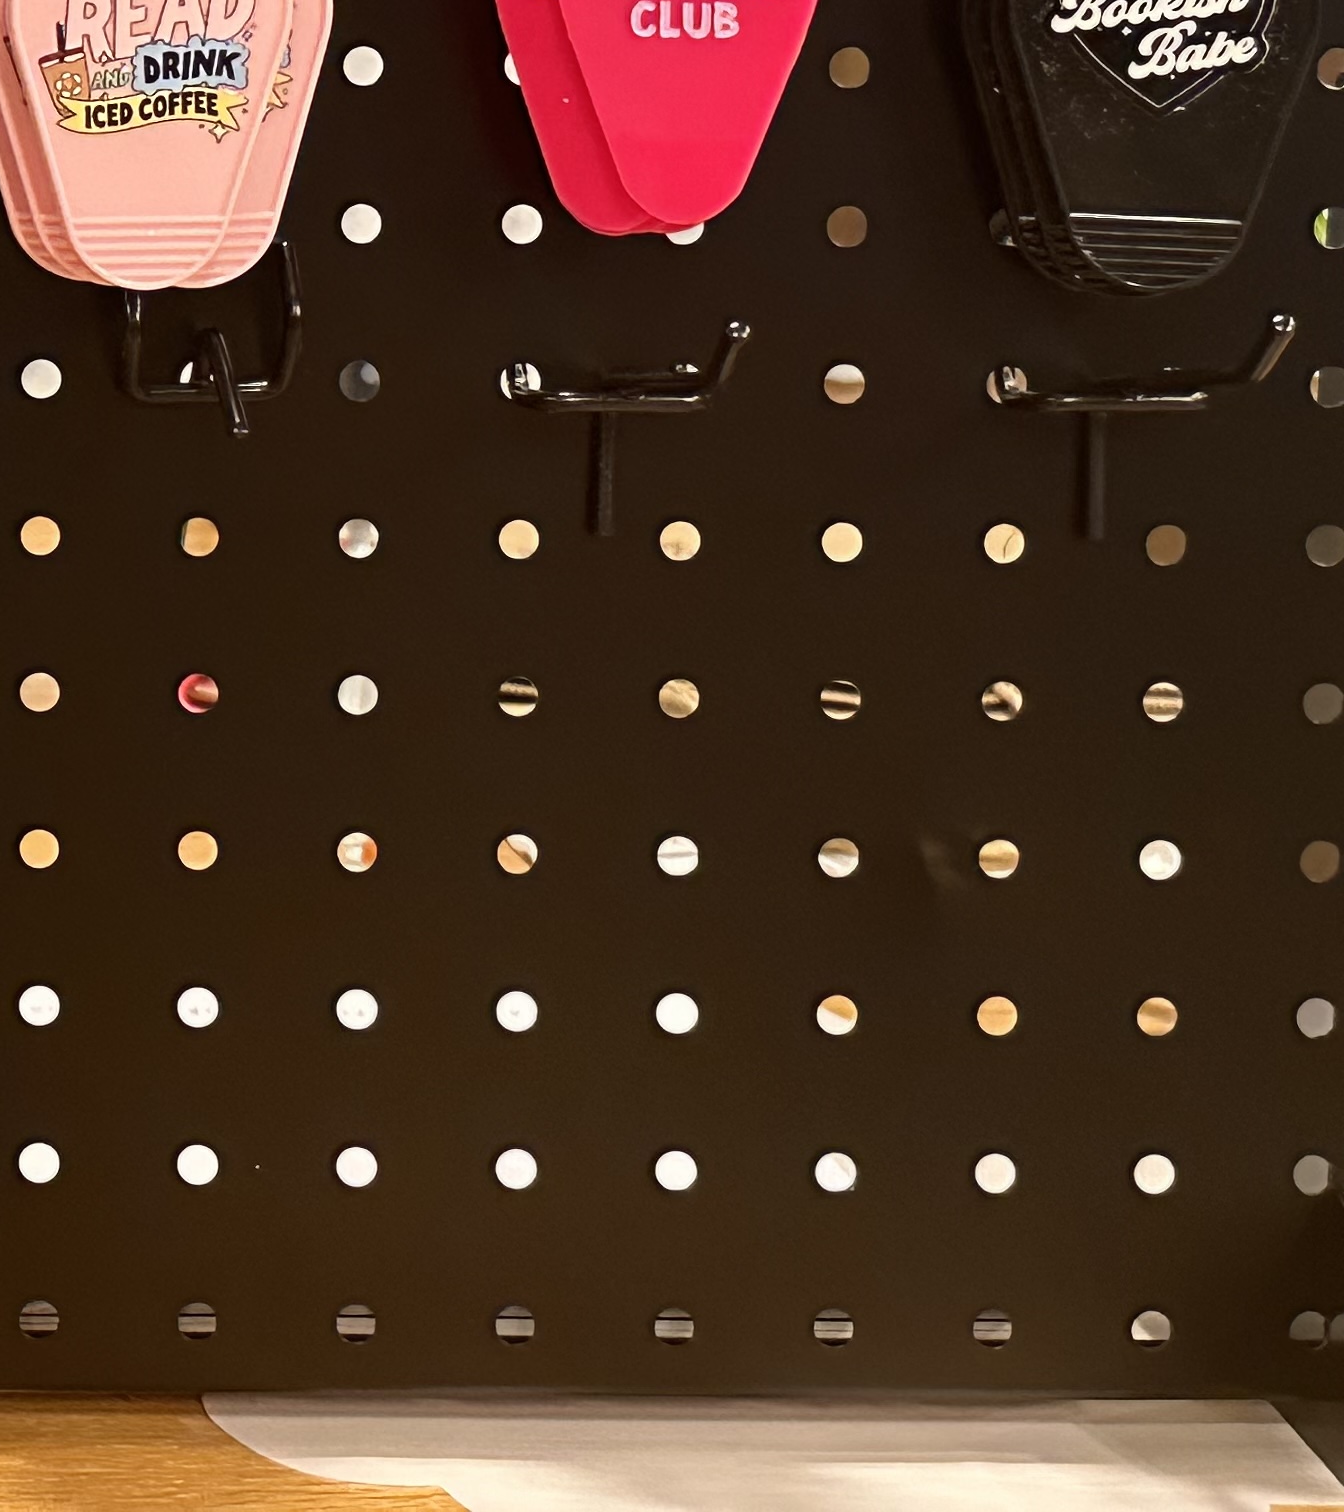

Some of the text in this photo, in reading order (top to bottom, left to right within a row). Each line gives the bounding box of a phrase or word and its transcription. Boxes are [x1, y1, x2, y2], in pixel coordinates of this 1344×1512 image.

[630, 0, 740, 39] CLUB
[91, 49, 242, 90] AND DRINK
[1127, 20, 1258, 80] Babe
[84, 92, 220, 130] ICED COFFEE
